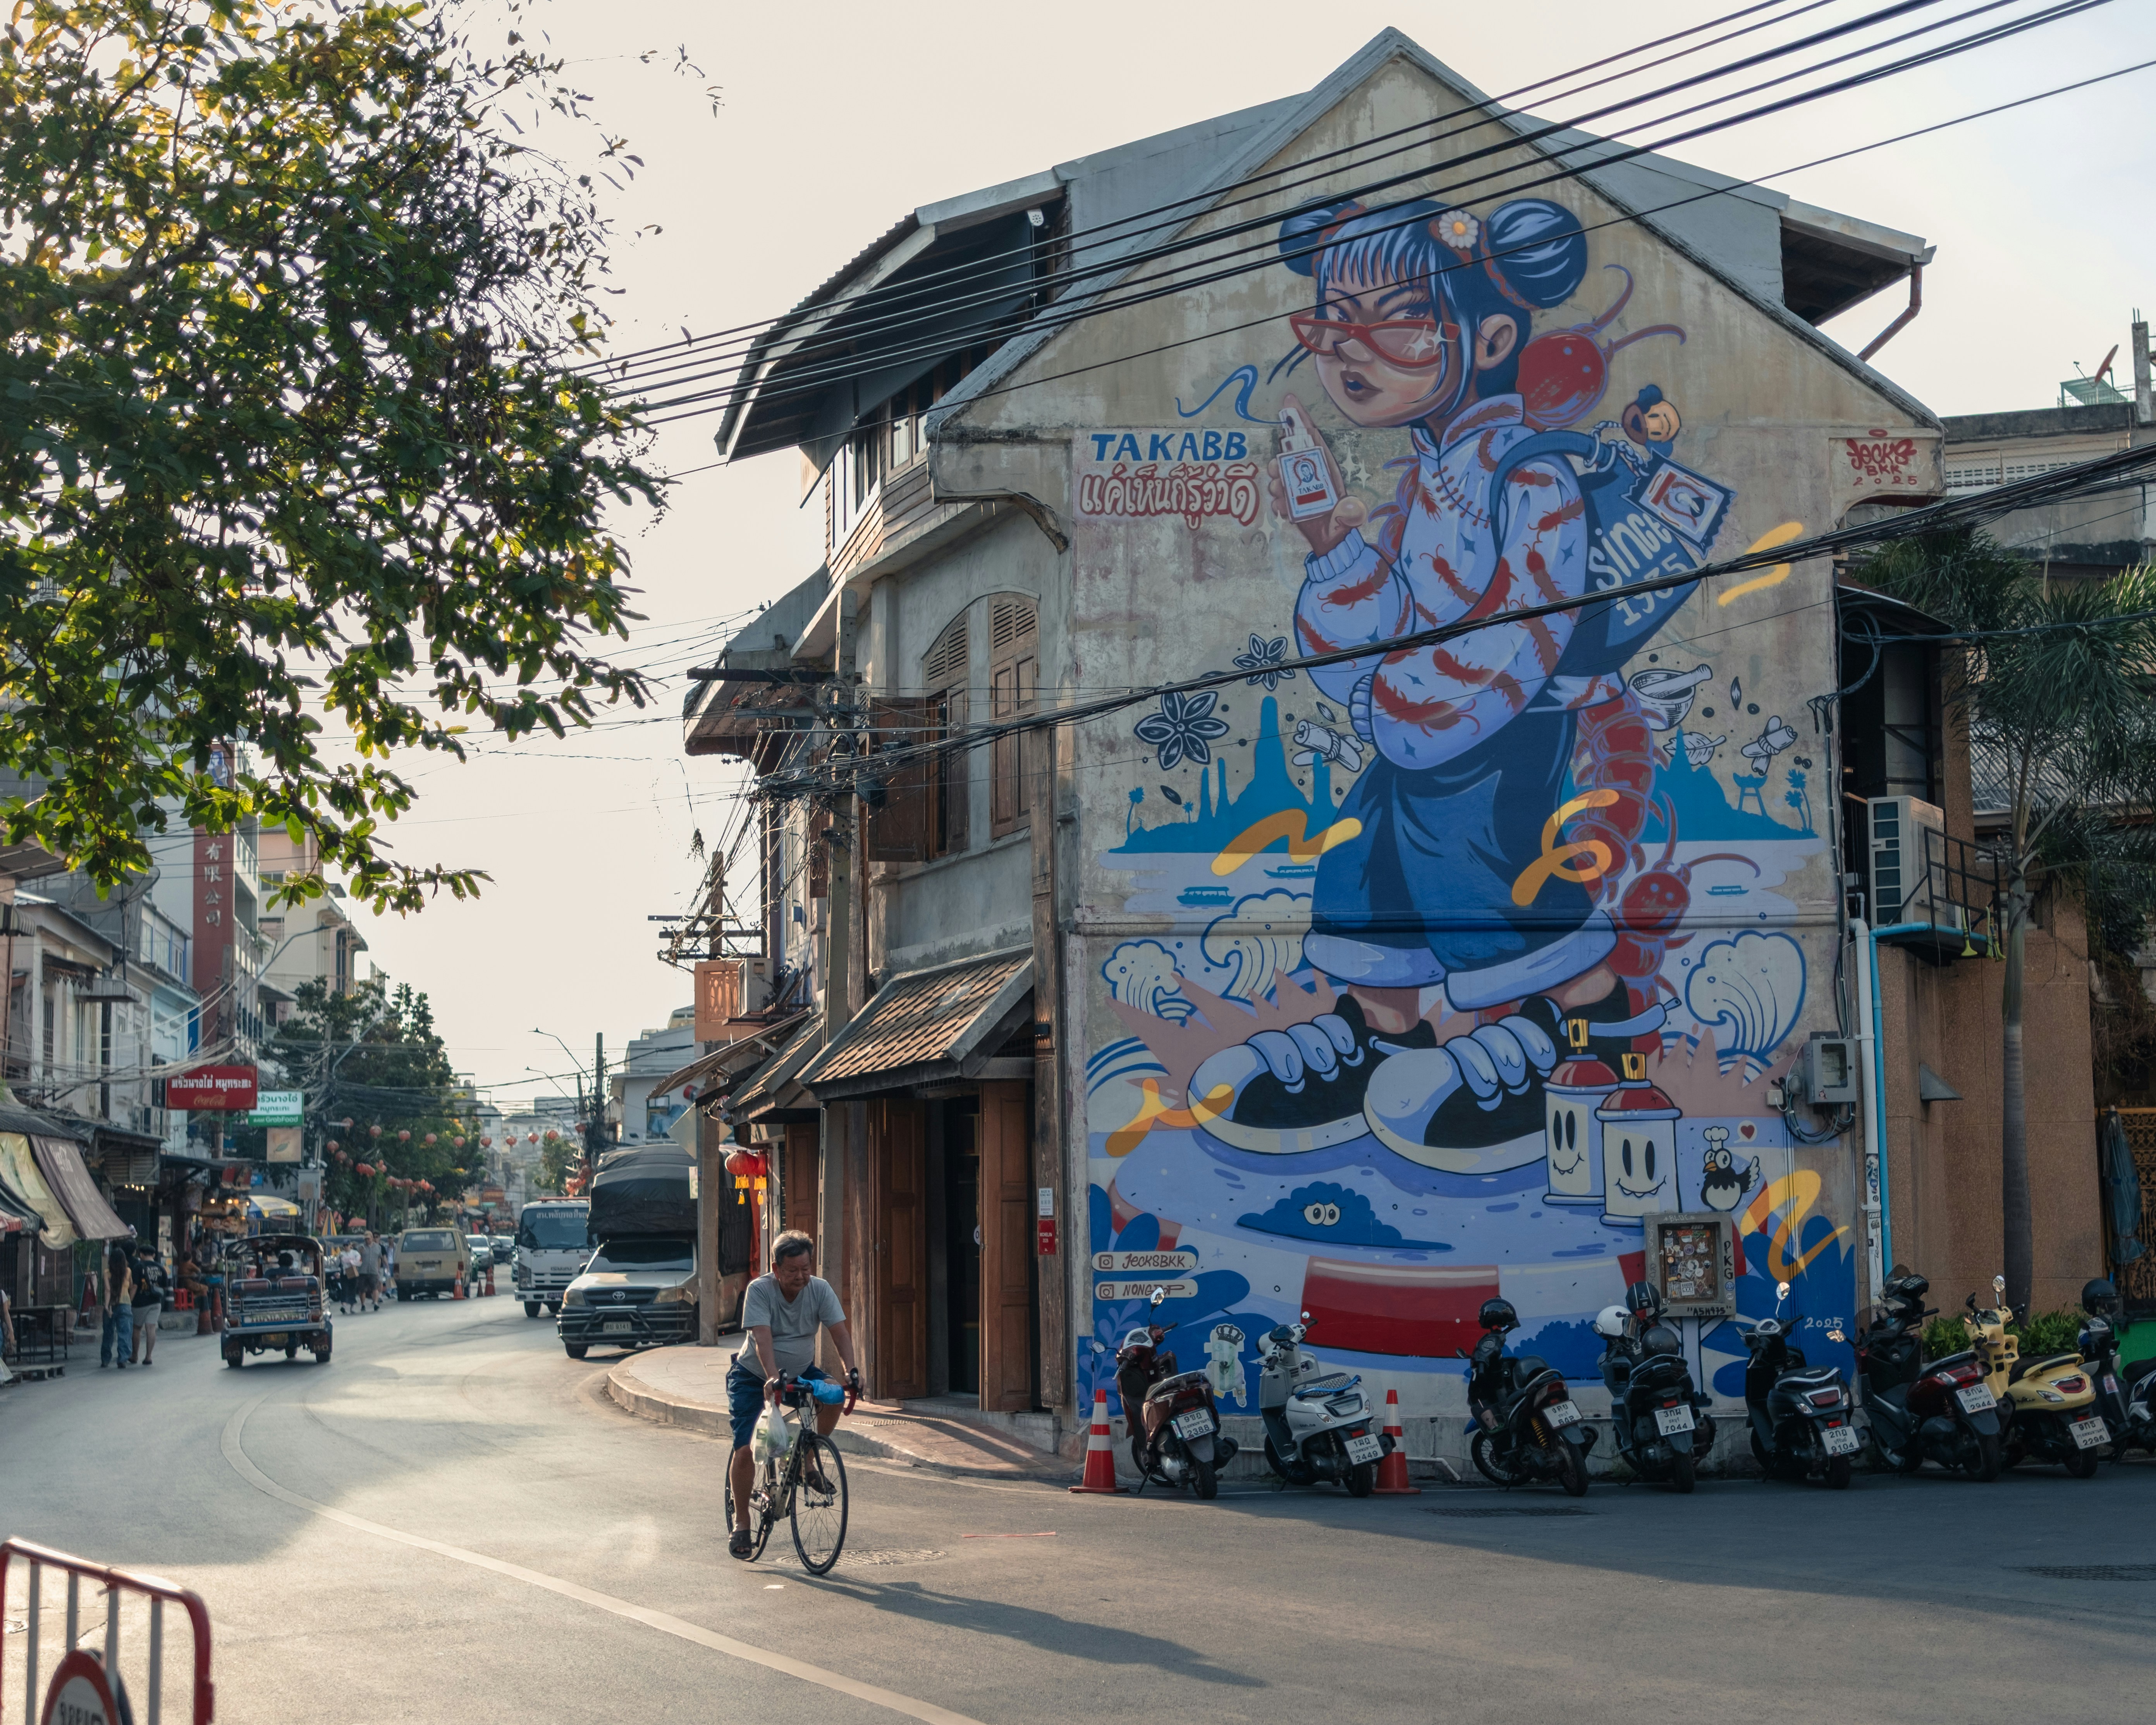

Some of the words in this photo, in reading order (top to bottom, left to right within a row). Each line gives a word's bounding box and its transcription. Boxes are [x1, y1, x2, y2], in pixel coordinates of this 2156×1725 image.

[1091, 431, 1247, 461] TAKABB
[1864, 465, 1902, 476] BKK
[1853, 475, 1917, 486] 2025
[1298, 483, 1324, 495] TAKABB
[1081, 462, 1260, 530] แค่เห็นก็รู้ว่าดี
[205, 831, 223, 927] 有限公司
[1804, 1316, 1844, 1329] 2025
[1970, 1400, 1992, 1410] 2944
[1558, 1415, 1575, 1425] 642
[1187, 1424, 1210, 1437] 2388
[1665, 1422, 1687, 1433] 7044
[2083, 1435, 2105, 1446] 2296
[1831, 1442, 1854, 1452] 9104
[1356, 1450, 1378, 1462] 2449
